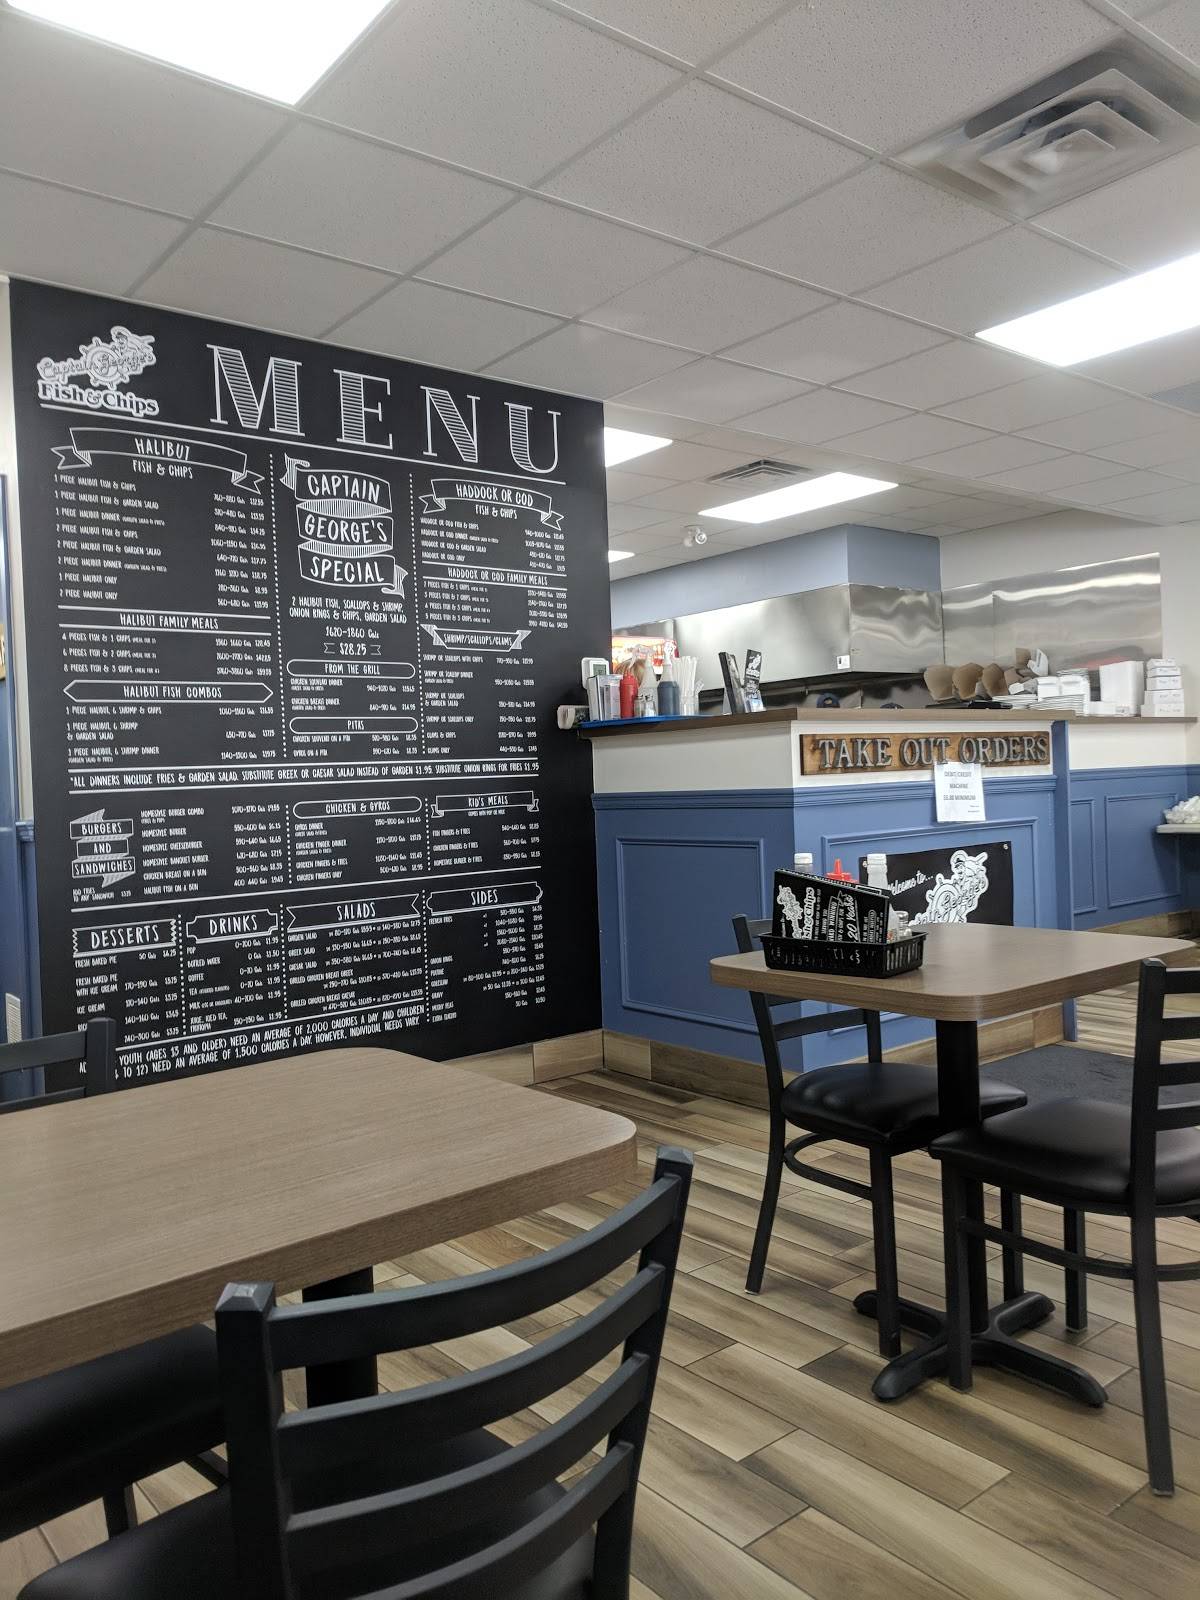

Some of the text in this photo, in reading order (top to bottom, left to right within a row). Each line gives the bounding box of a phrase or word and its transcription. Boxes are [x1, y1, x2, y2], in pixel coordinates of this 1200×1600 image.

[206, 343, 562, 474] MENU
[134, 437, 190, 461] HALIBUT
[132, 459, 193, 479] FISH & CHIPS
[307, 474, 380, 504] CAPTAIN
[455, 484, 534, 507] HADDOCK OR COD
[475, 504, 518, 520] FISH & CHIPS
[304, 514, 387, 544] GEORGE'S
[310, 556, 385, 583] SPECIAL
[448, 567, 548, 586] HADDOCK OR COD FAMILY MEALS
[292, 596, 296, 607] 2
[299, 596, 323, 608] HALIBUT
[343, 599, 371, 611] SCALLOPS
[372, 601, 380, 611] &
[120, 613, 219, 630] HALIBUT FAMILY MEALS
[289, 607, 310, 619] ONION
[312, 608, 331, 620] RINGS
[333, 610, 340, 620] &
[364, 612, 388, 623] GARDEN
[390, 613, 407, 624] SALAD
[339, 642, 367, 656] $28.25
[324, 664, 380, 675] FROM THE GRILL
[123, 685, 222, 698] HALIBUT FISH COMBOS
[347, 720, 365, 731] PITAS
[817, 736, 1049, 769] TAKE OUT ORDERS
[89, 775, 120, 787] DINNERS
[123, 773, 153, 786] INCLUDE
[156, 773, 175, 785] FRIES
[178, 773, 186, 783] &
[188, 771, 216, 783] GARDEN
[241, 769, 275, 781] SUBSTITUTE
[277, 769, 299, 780] GREEK
[301, 768, 310, 779] OR
[312, 768, 334, 779] CAESAR
[336, 767, 355, 778] SALAD
[356, 766, 379, 777] INSTEAD
[381, 766, 389, 776] OF
[391, 765, 413, 775] GARDEN
[435, 764, 462, 774] SUBSTITUTE
[464, 764, 481, 773] ONION
[482, 763, 497, 773] RINGS
[498, 763, 508, 772] FOR
[509, 762, 523, 772] FRIES
[325, 801, 391, 815] CHICKEN & GYROS
[468, 795, 509, 808] KID'S MEALS
[81, 822, 122, 836] BURGERS
[93, 843, 112, 854] AND
[74, 860, 133, 876] SANDWICHES
[470, 889, 498, 906] SIDES
[336, 901, 376, 921] SALADS
[209, 914, 258, 936] DRINKS
[91, 925, 160, 950] DESSERTS
[119, 1052, 143, 1066] YOUTH
[146, 1048, 167, 1062] (AGES
[170, 1045, 180, 1057] 13
[183, 1043, 198, 1055] AND
[201, 1039, 227, 1052] OLDER)
[230, 1035, 248, 1047] NEED
[251, 1033, 261, 1042] AN
[263, 1026, 292, 1041] AVERAGE
[295, 1025, 303, 1035] OF
[331, 1016, 358, 1030] CALORIES
[360, 1014, 365, 1024] A
[367, 1012, 379, 1022] DAY
[382, 1010, 394, 1020] AND
[397, 1004, 425, 1018] CHILDREN
[123, 1066, 132, 1078] TO
[136, 1064, 148, 1077] 12)
[152, 1060, 171, 1073] NEED
[175, 1057, 185, 1069] AN
[188, 1051, 219, 1066] AVERAGE
[222, 1049, 231, 1060] OF
[261, 1039, 290, 1053] CALORIES
[292, 1037, 298, 1048] A
[349, 1022, 381, 1037] INDIVIDUAL
[384, 1019, 403, 1031] NEEDS
